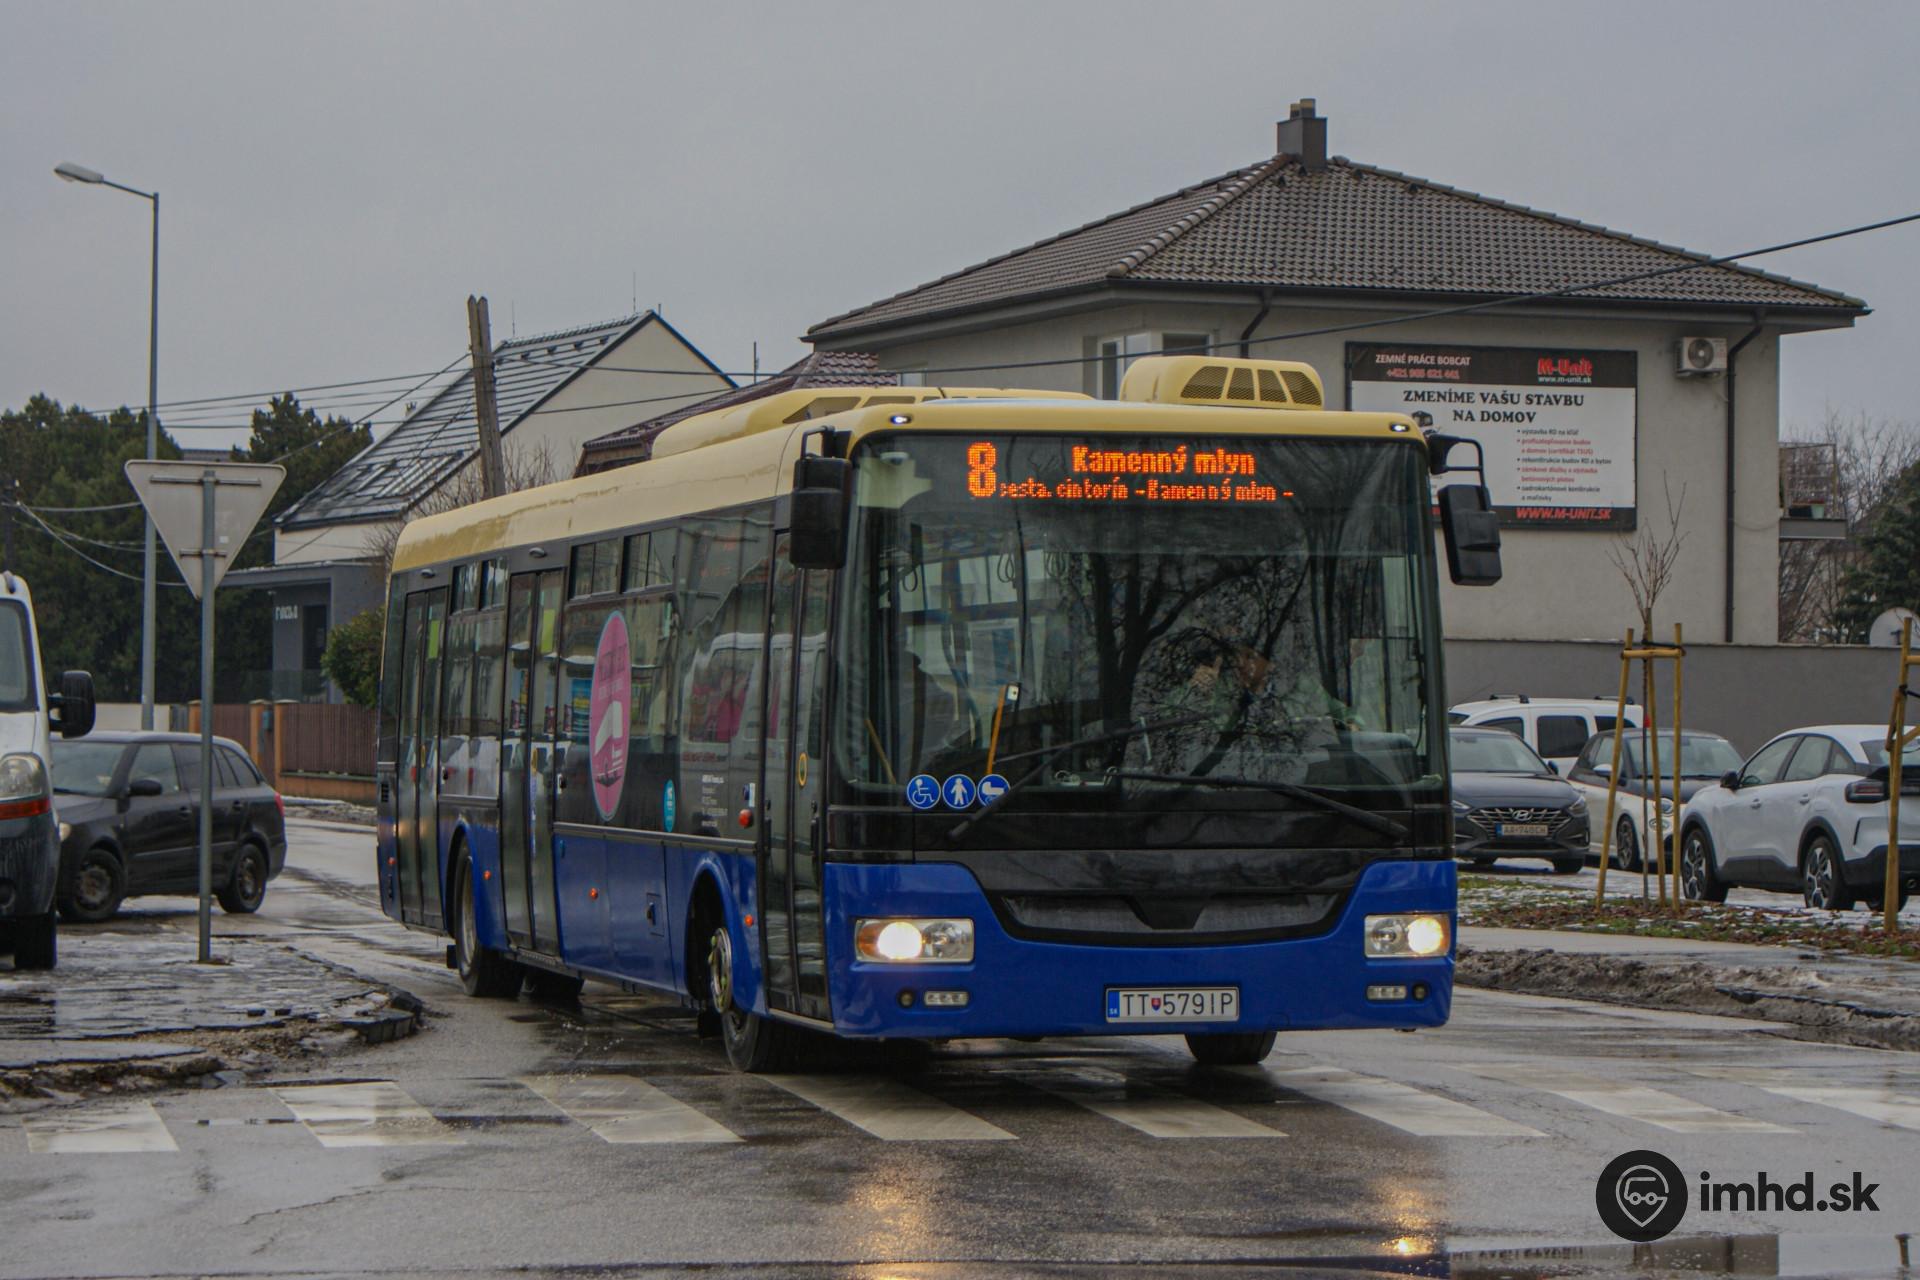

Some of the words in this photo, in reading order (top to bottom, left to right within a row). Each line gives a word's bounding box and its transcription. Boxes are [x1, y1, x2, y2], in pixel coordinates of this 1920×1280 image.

[1375, 353, 1406, 364] ZEMNÉ
[1408, 353, 1436, 365] PRÁCE
[1437, 356, 1472, 366] BOBCAT
[1537, 356, 1593, 376] M-Unit
[1403, 388, 1476, 404] ZMENÍME
[1480, 390, 1521, 405] VAŠU
[1525, 394, 1585, 406] STAVBU
[1453, 410, 1475, 422] NA
[1480, 411, 1537, 423] DOMOV
[967, 441, 997, 498] 8
[1072, 445, 1187, 474] Kamenný
[1194, 448, 1256, 475] mlyn
[1056, 476, 1129, 499] cintorín
[1235, 480, 1277, 500] mlyn
[1516, 507, 1612, 520] WWW.M-UNIT.SK
